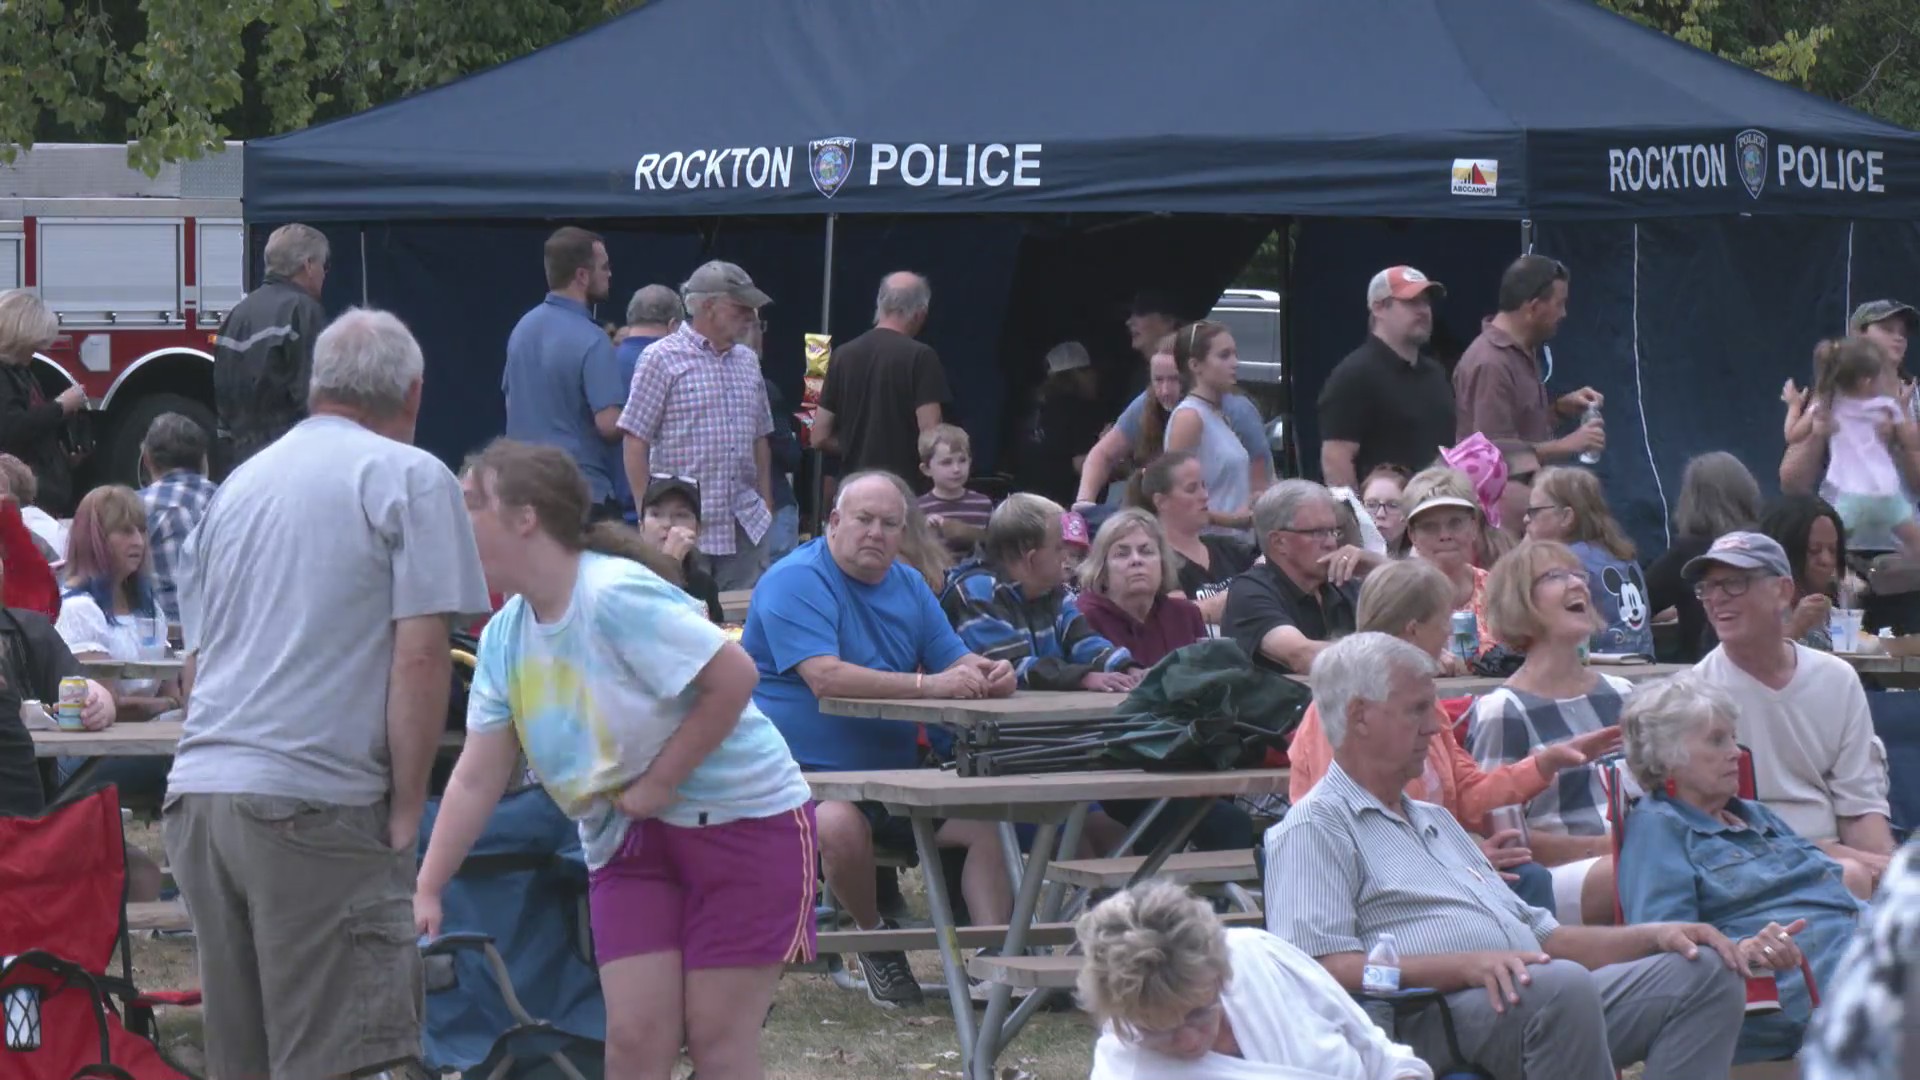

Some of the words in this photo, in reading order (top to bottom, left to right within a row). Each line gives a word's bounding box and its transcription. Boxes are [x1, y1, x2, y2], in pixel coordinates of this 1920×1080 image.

[1738, 133, 1766, 148] POLICE
[635, 146, 793, 190] ROCKTON
[870, 143, 1043, 187] POLICE
[1609, 143, 1727, 192] ROCKTON
[1778, 144, 1885, 192] POLICE
[1453, 185, 1495, 194] ABCCANOPY
